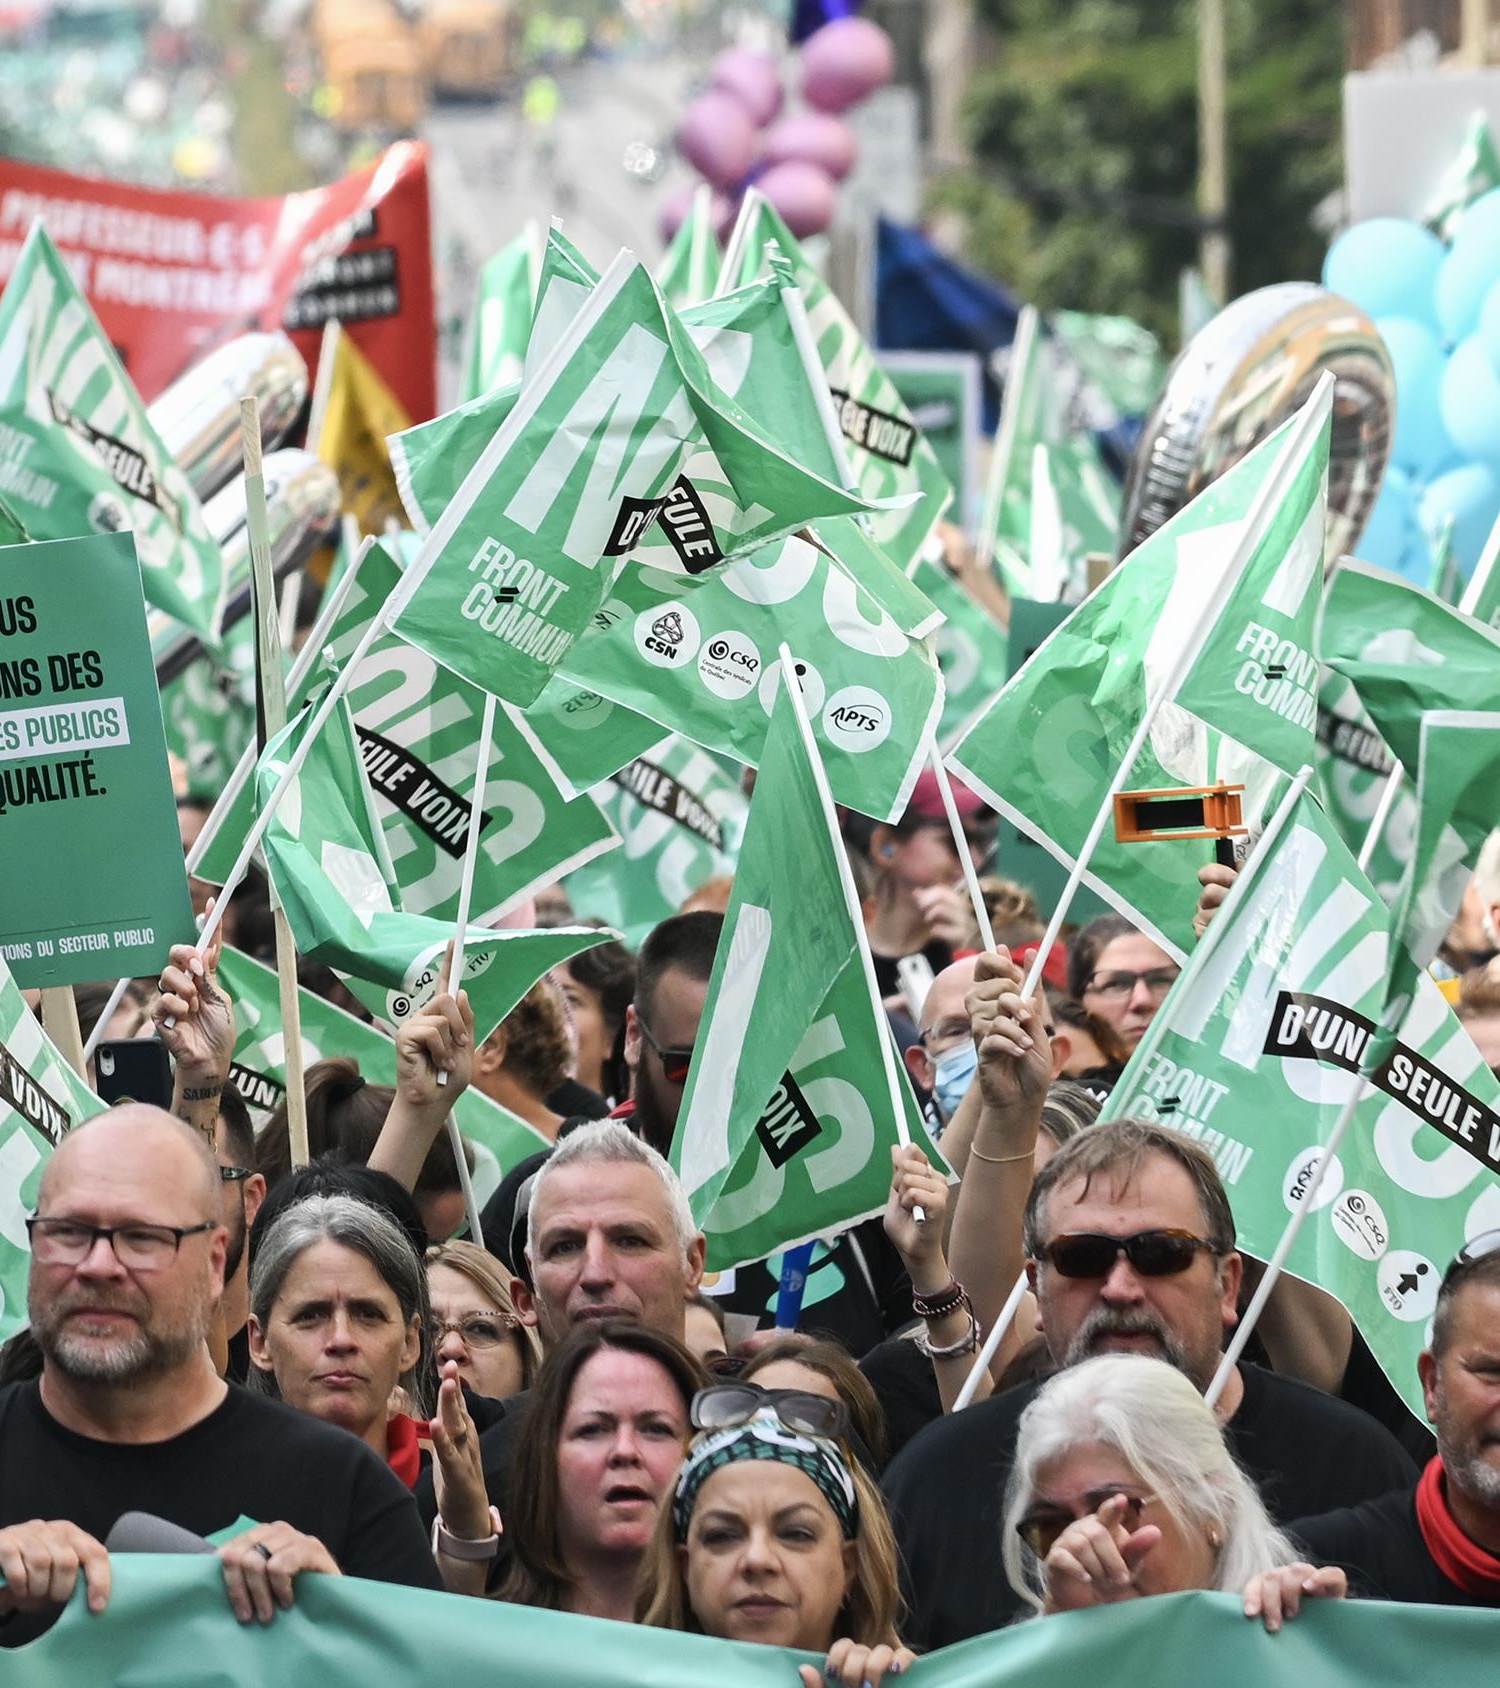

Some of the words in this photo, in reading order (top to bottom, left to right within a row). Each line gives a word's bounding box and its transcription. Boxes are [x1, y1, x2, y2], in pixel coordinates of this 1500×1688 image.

[467, 536, 570, 617] FRONT
[644, 636, 677, 660] CSN
[729, 651, 759, 672] CSQ
[49, 650, 105, 693] DES
[25, 707, 121, 748] PUBLICS
[829, 706, 880, 732] APTS
[405, 780, 473, 845] VOIX
[36, 940, 54, 957] DU
[58, 932, 109, 954] SECTEUR
[114, 927, 155, 947] PUBLIC
[9, 1065, 63, 1145] VOIX
[1387, 1054, 1483, 1143] SEULE
